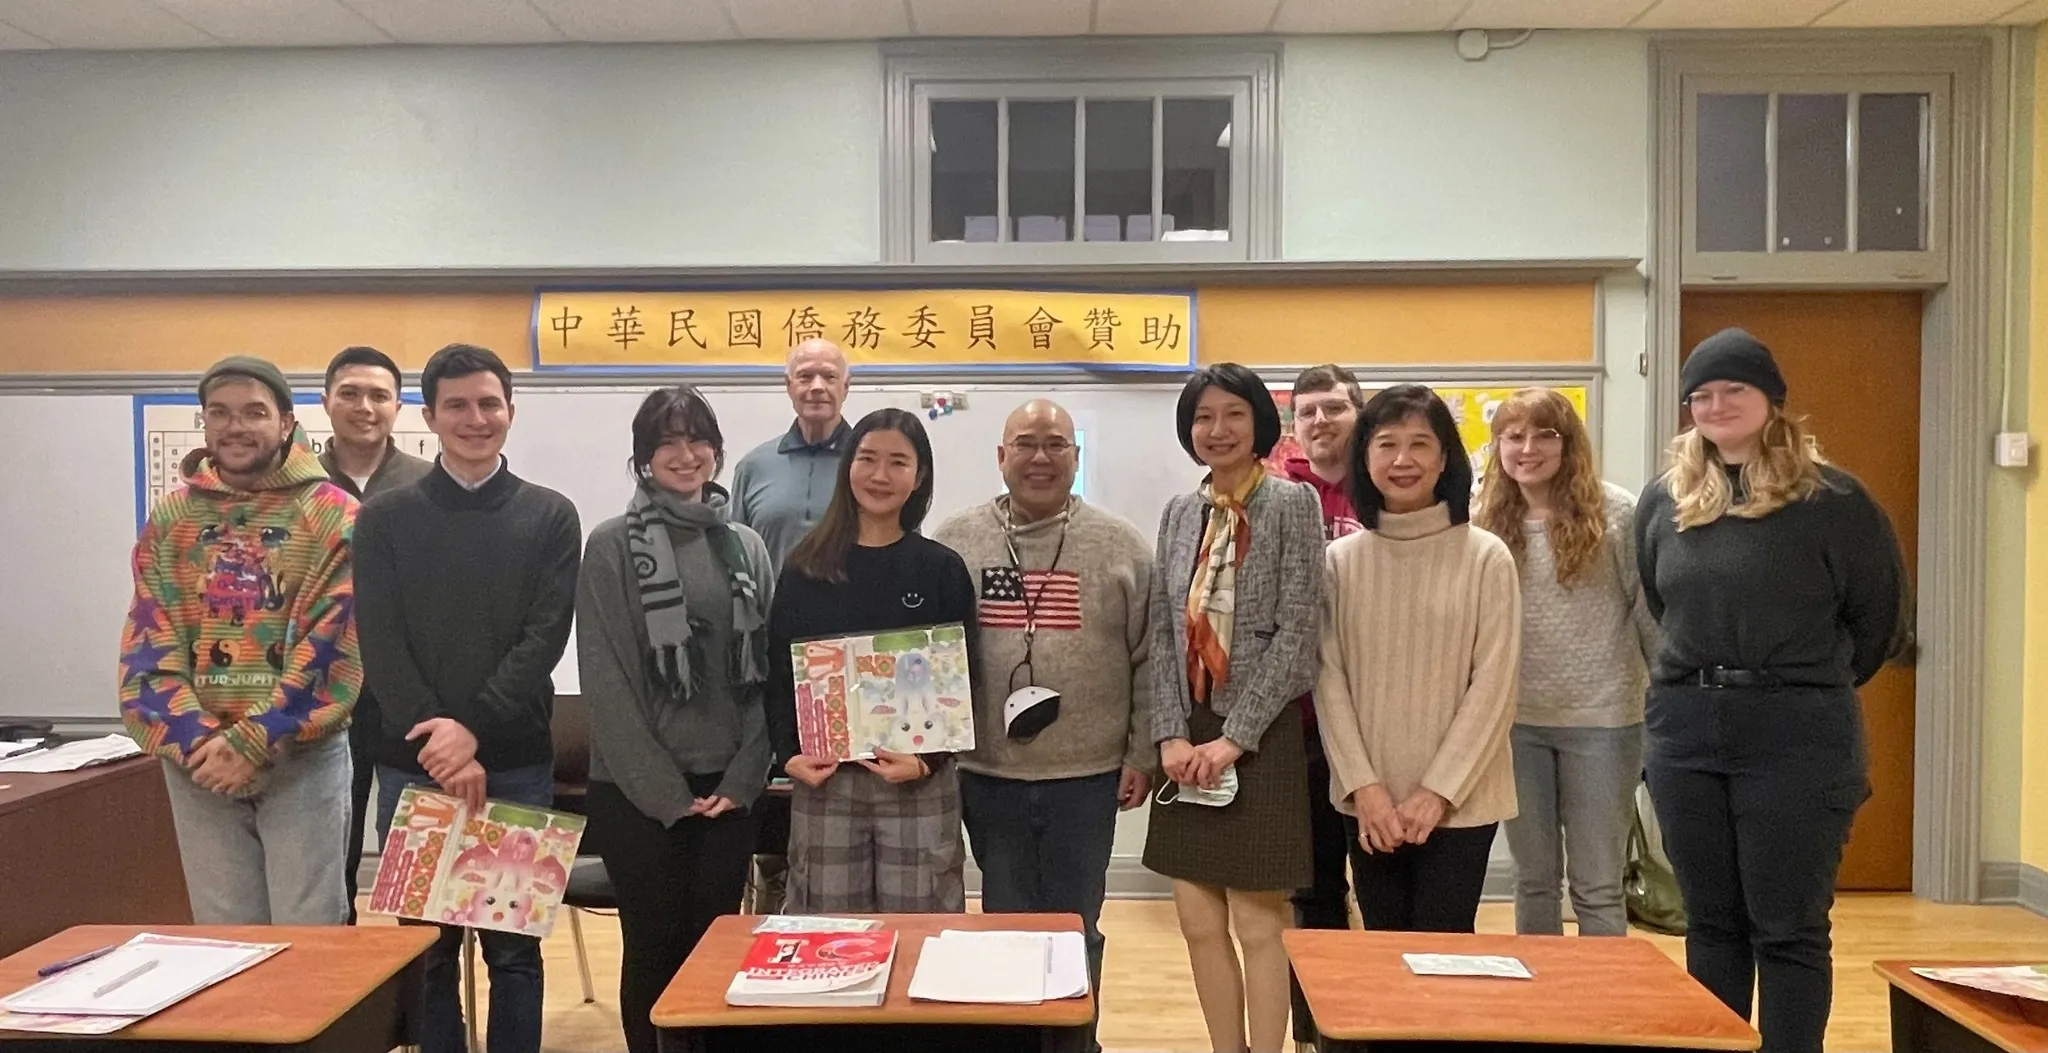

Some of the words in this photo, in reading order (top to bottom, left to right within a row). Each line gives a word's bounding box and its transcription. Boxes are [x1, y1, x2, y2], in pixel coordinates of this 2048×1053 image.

[550, 304, 1182, 352] 中華民國僑務委員會贊助
[311, 438, 322, 454] b
[418, 439, 424, 455] f
